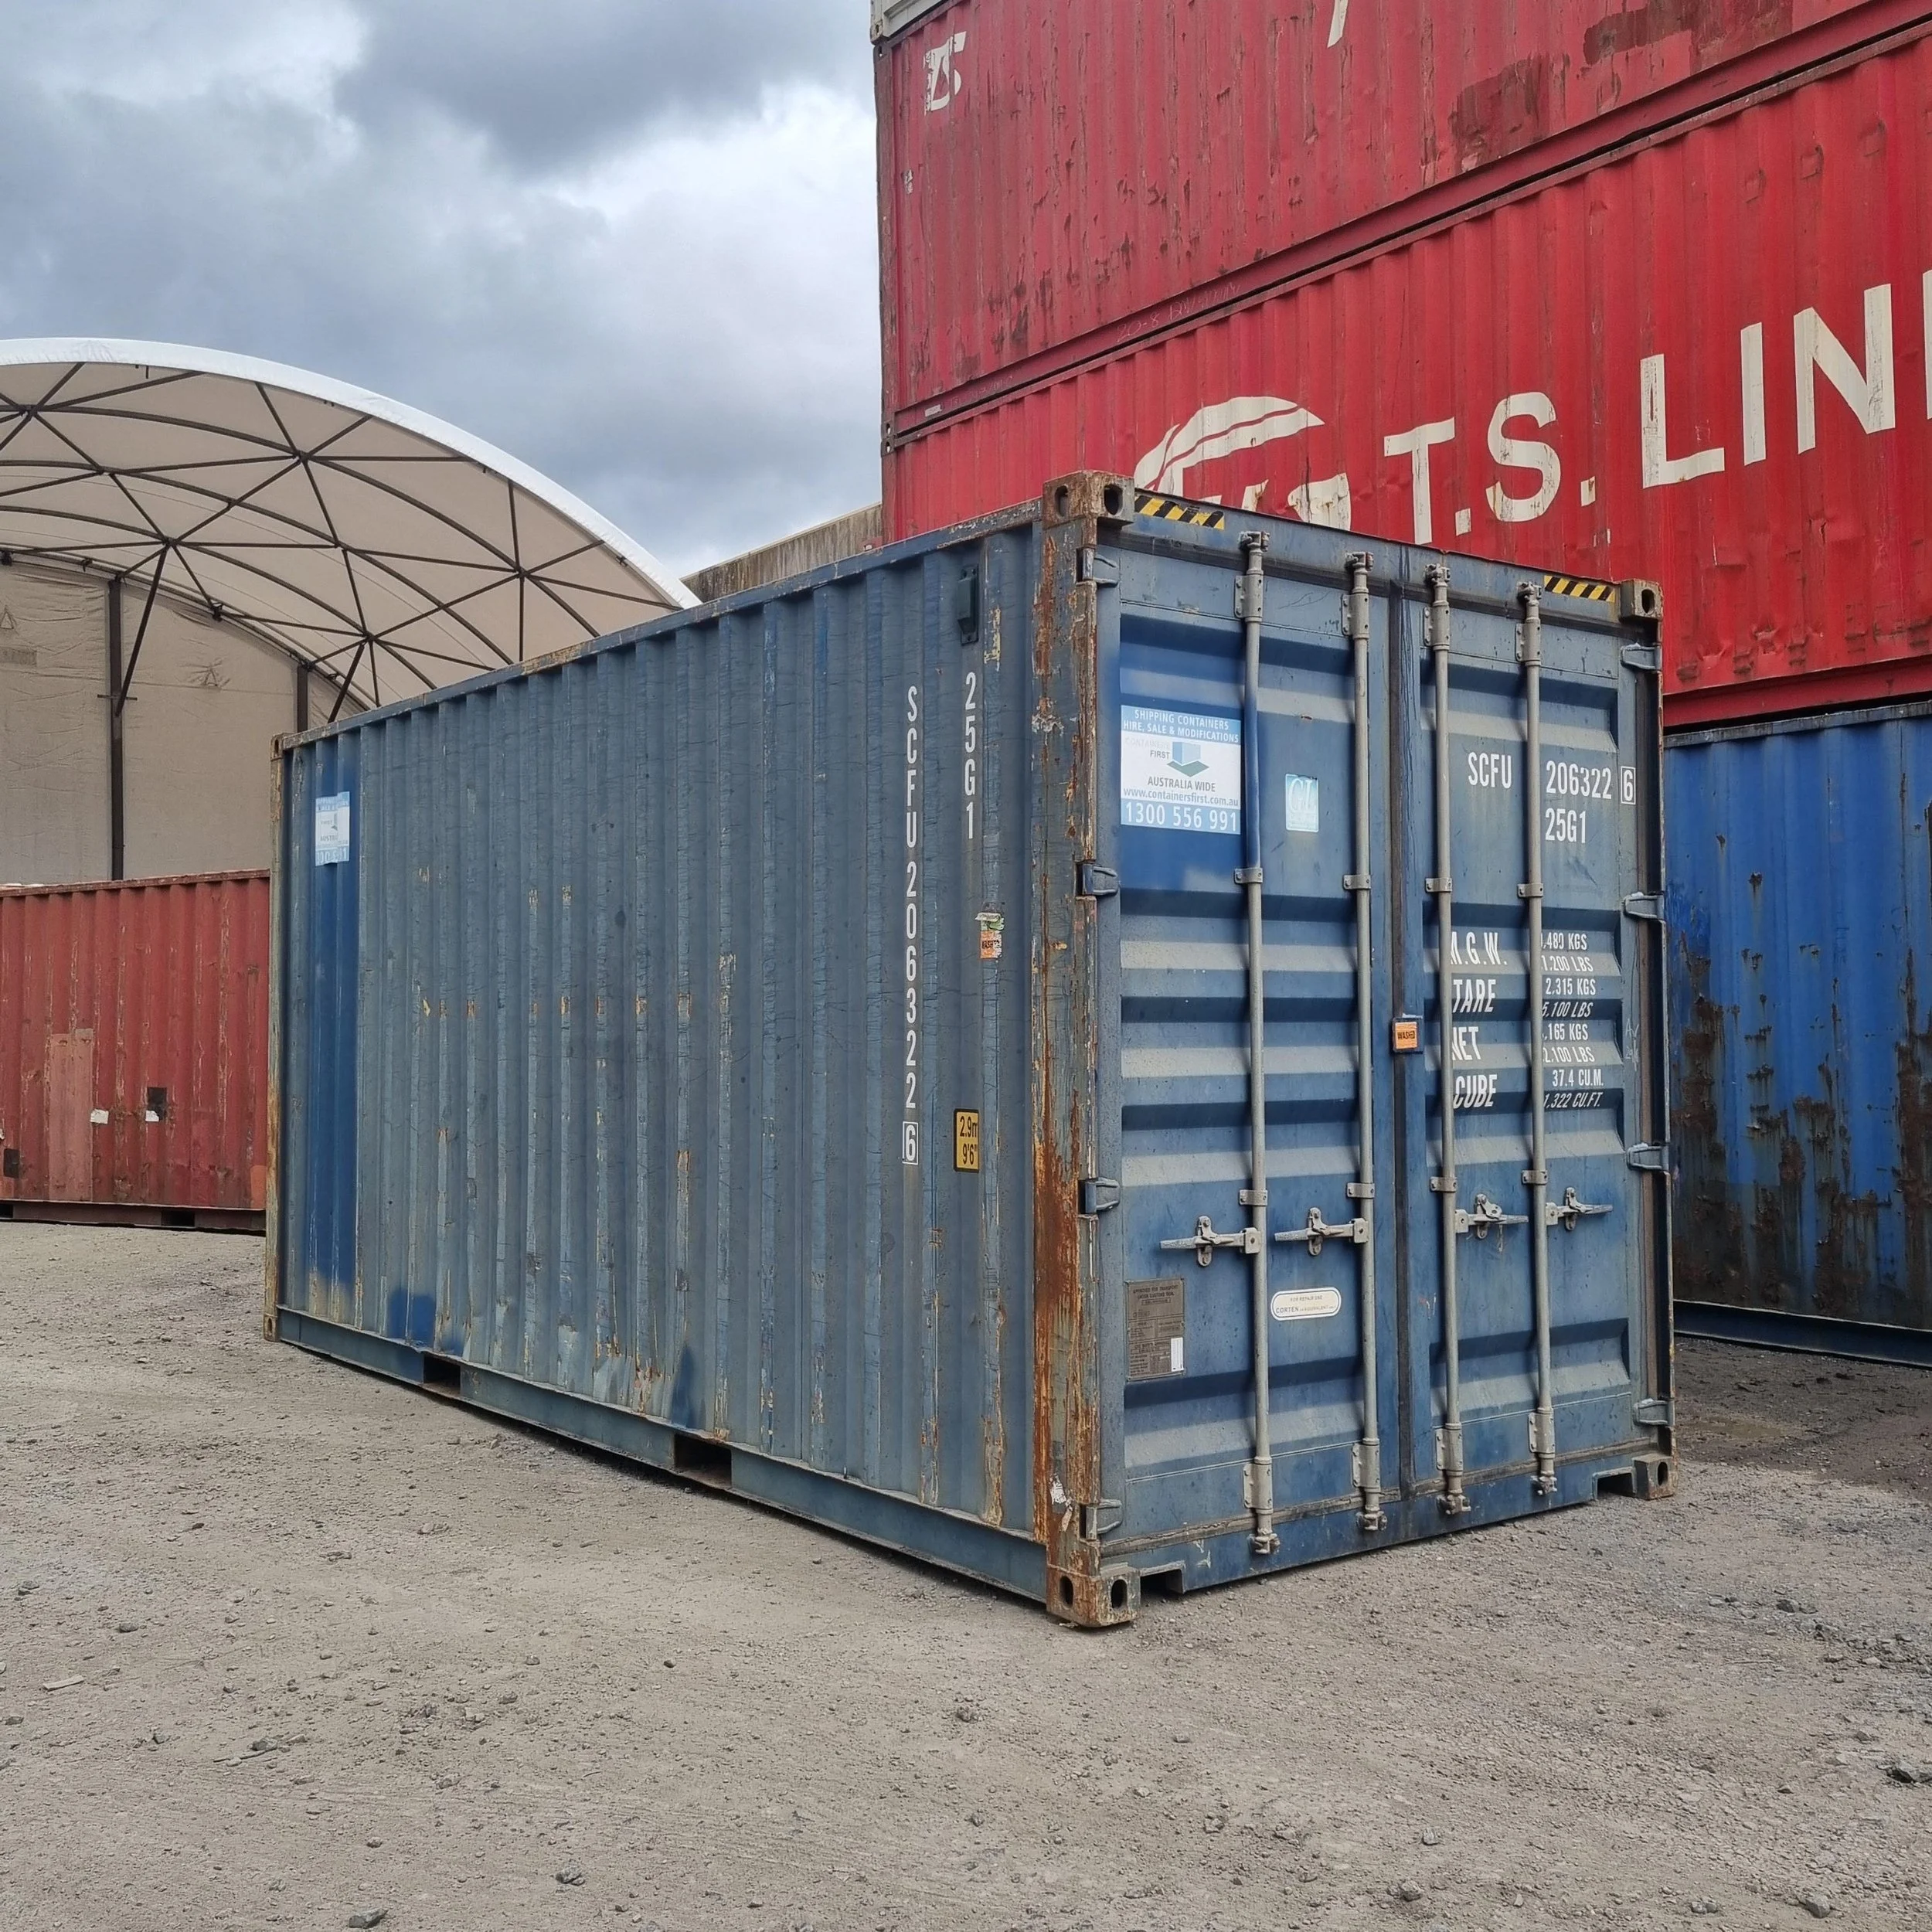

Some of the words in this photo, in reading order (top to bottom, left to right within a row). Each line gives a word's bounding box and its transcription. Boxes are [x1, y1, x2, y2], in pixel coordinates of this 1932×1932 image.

[1384, 392, 1596, 545] T.S.
[1124, 720, 1145, 732] HIRE,
[1148, 723, 1167, 734] SALE
[1170, 726, 1175, 735] &
[1178, 727, 1239, 743] MODIFICATIONS
[1134, 709, 1175, 725] SHIPPING
[1178, 715, 1229, 730] CONTAINERS
[906, 685, 917, 848] SCFU
[965, 672, 976, 838] 25G1
[1150, 750, 1170, 760] FIRST
[1148, 776, 1192, 790] AUSTRALIA
[1195, 781, 1216, 792] WIDE
[1468, 751, 1512, 789] SCFU
[1546, 760, 1612, 800] 206322
[1621, 767, 1634, 804] 6
[1124, 787, 1238, 807] www.containersfirst.com.au
[1126, 802, 1165, 825] 1300
[1173, 805, 1202, 828] 556
[1209, 809, 1236, 832] 991
[1546, 808, 1586, 843] 25G1
[1568, 933, 1587, 951] KGS
[1570, 956, 1594, 972] LBS
[906, 861, 917, 1109] 206322
[1453, 978, 1496, 1012] TARE
[1577, 978, 1596, 995] KGS
[1570, 1002, 1594, 1018] LBS
[1569, 1023, 1589, 1040] KGS
[1572, 1046, 1595, 1063] LBS
[1453, 1074, 1498, 1109] CUBE
[1552, 1069, 1574, 1087] 37.4
[1578, 1069, 1604, 1087] CU.M.
[904, 1124, 917, 1163] 6
